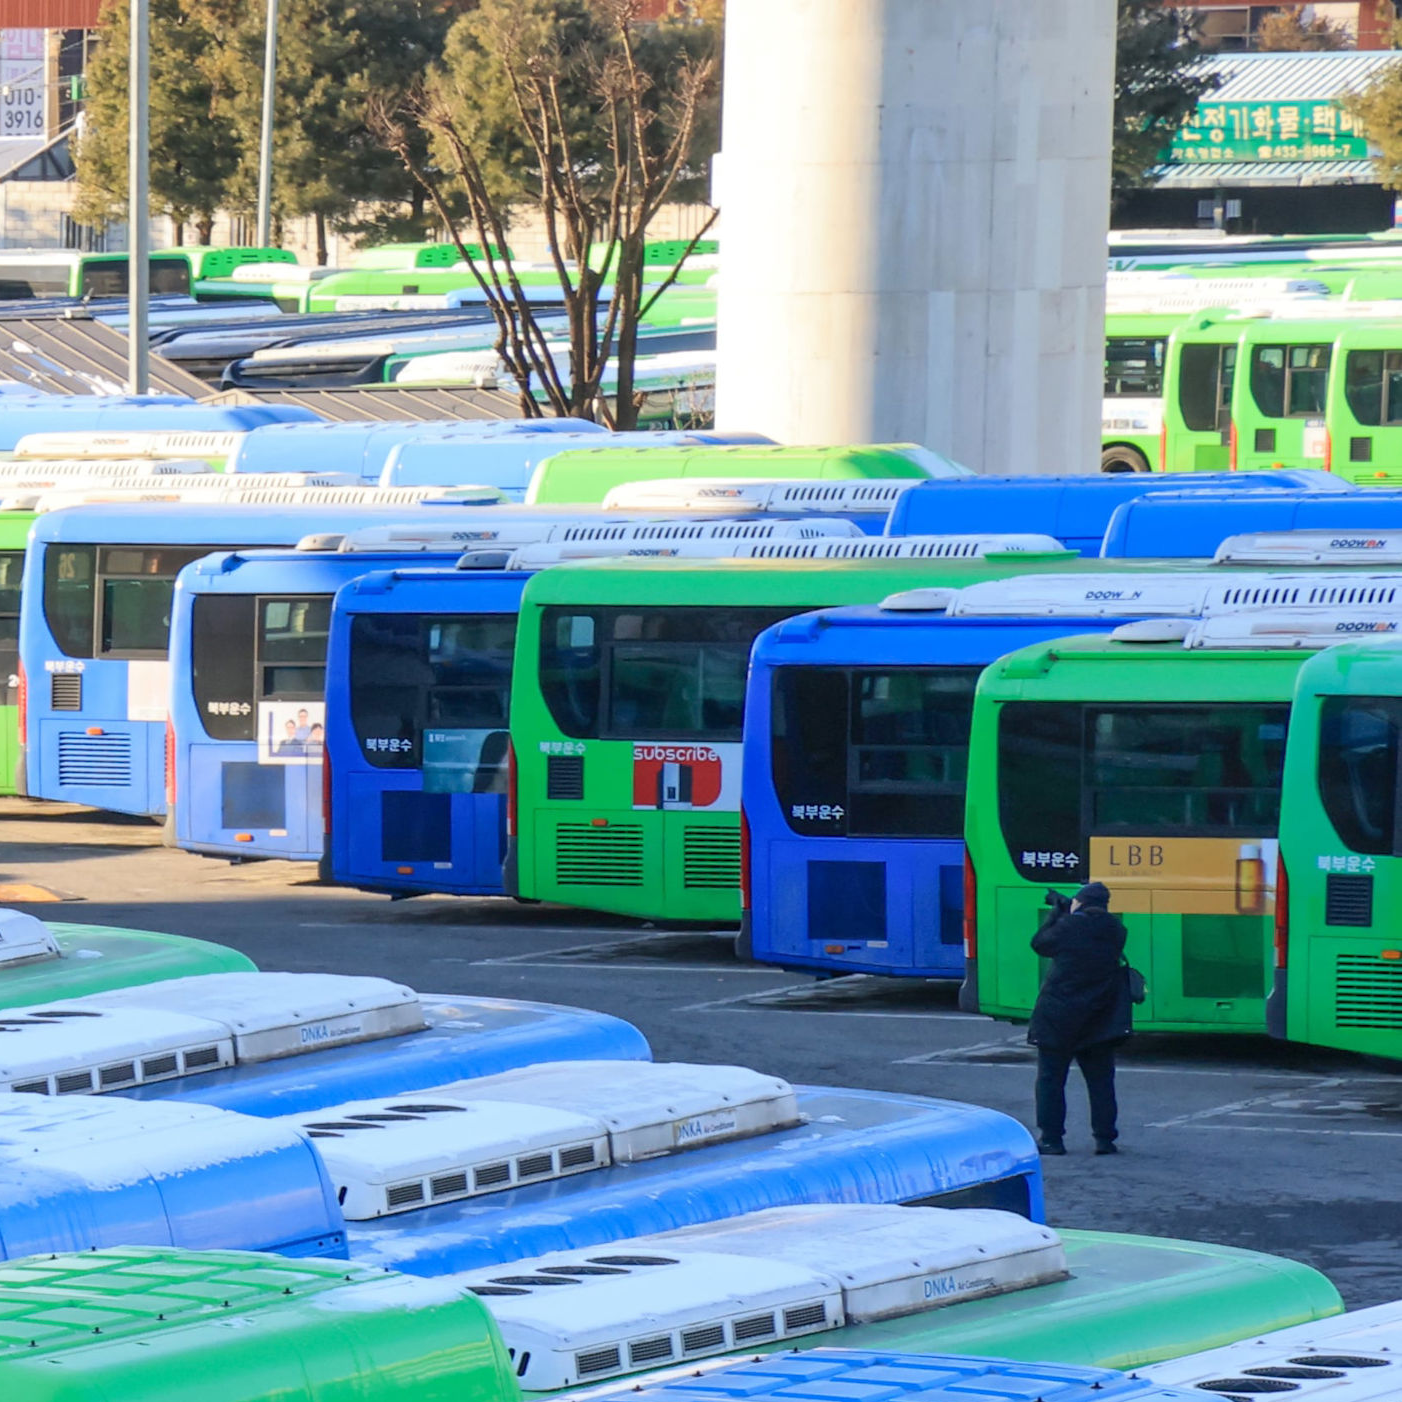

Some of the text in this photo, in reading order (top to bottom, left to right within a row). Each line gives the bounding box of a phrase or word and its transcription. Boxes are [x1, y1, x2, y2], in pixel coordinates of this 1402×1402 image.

[4, 111, 44, 128] 3916
[1085, 590, 1142, 600] DOOWN
[207, 702, 251, 716] 북부운수
[366, 737, 412, 752] 북부운수
[633, 746, 718, 761] subscribe
[792, 804, 844, 820] 북부운수
[1021, 851, 1079, 868] 북부운수
[1109, 845, 1163, 866] LBB
[1317, 855, 1375, 873] 북부운수
[301, 1024, 328, 1043] DNKA
[924, 1275, 956, 1298] DNKA
